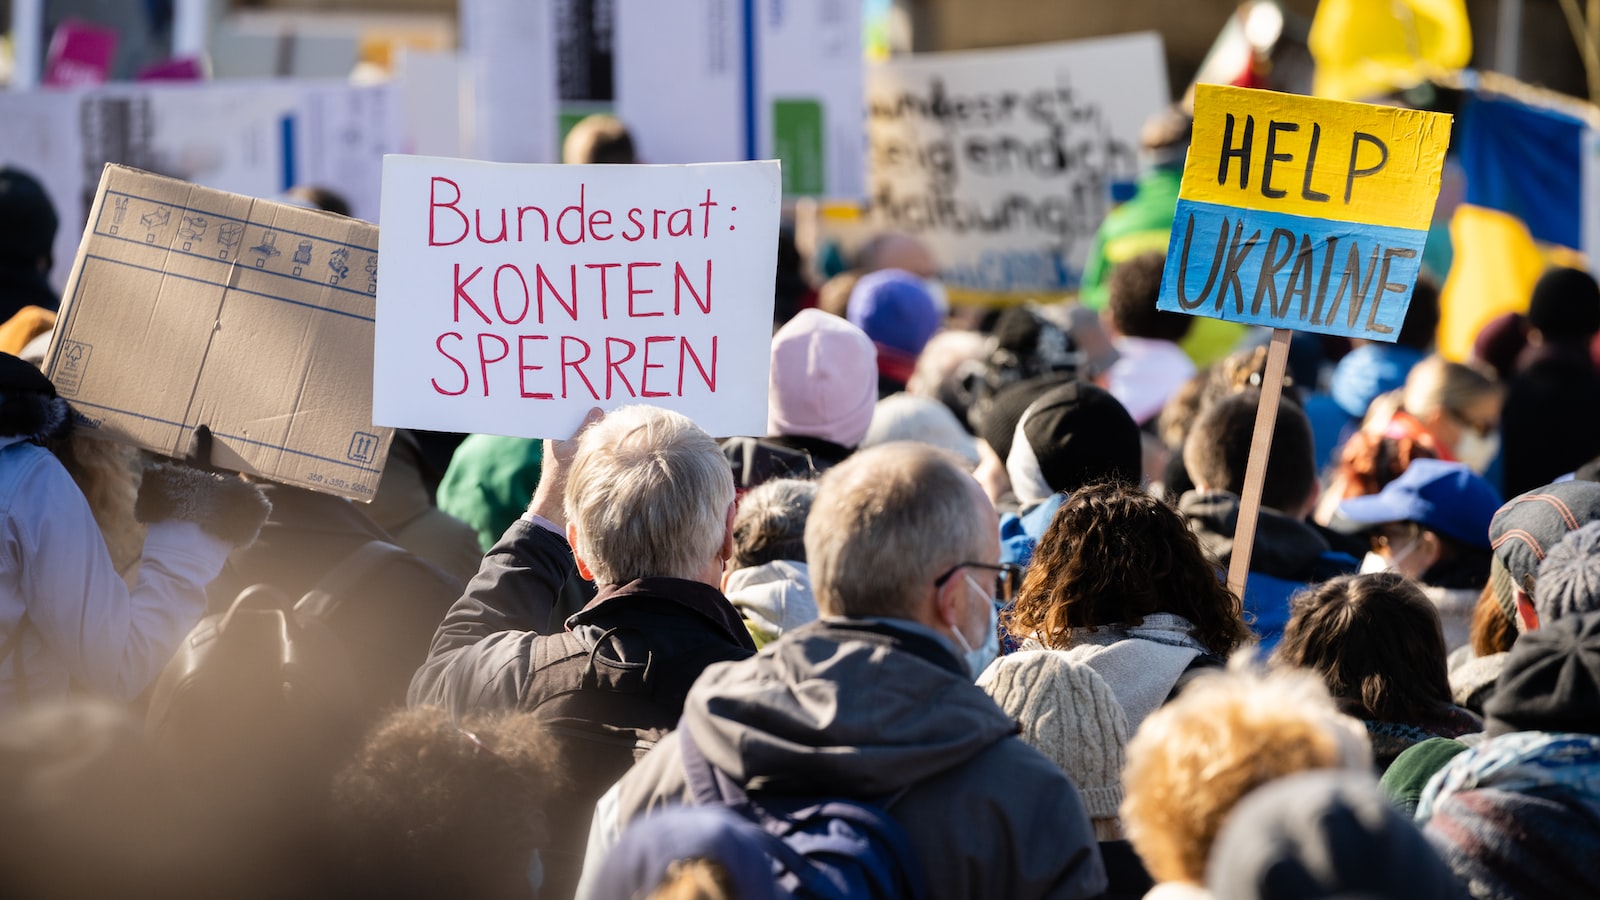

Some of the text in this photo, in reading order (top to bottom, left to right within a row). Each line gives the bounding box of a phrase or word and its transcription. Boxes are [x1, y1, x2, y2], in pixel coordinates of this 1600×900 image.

[1217, 112, 1389, 205] HELP
[428, 176, 738, 247] Bundesrat:
[453, 259, 713, 325] KONTEN
[1177, 212, 1417, 334] UKRAINE
[430, 331, 719, 401] SPERREN
[307, 472, 323, 482] 350
[329, 478, 345, 488] 350
